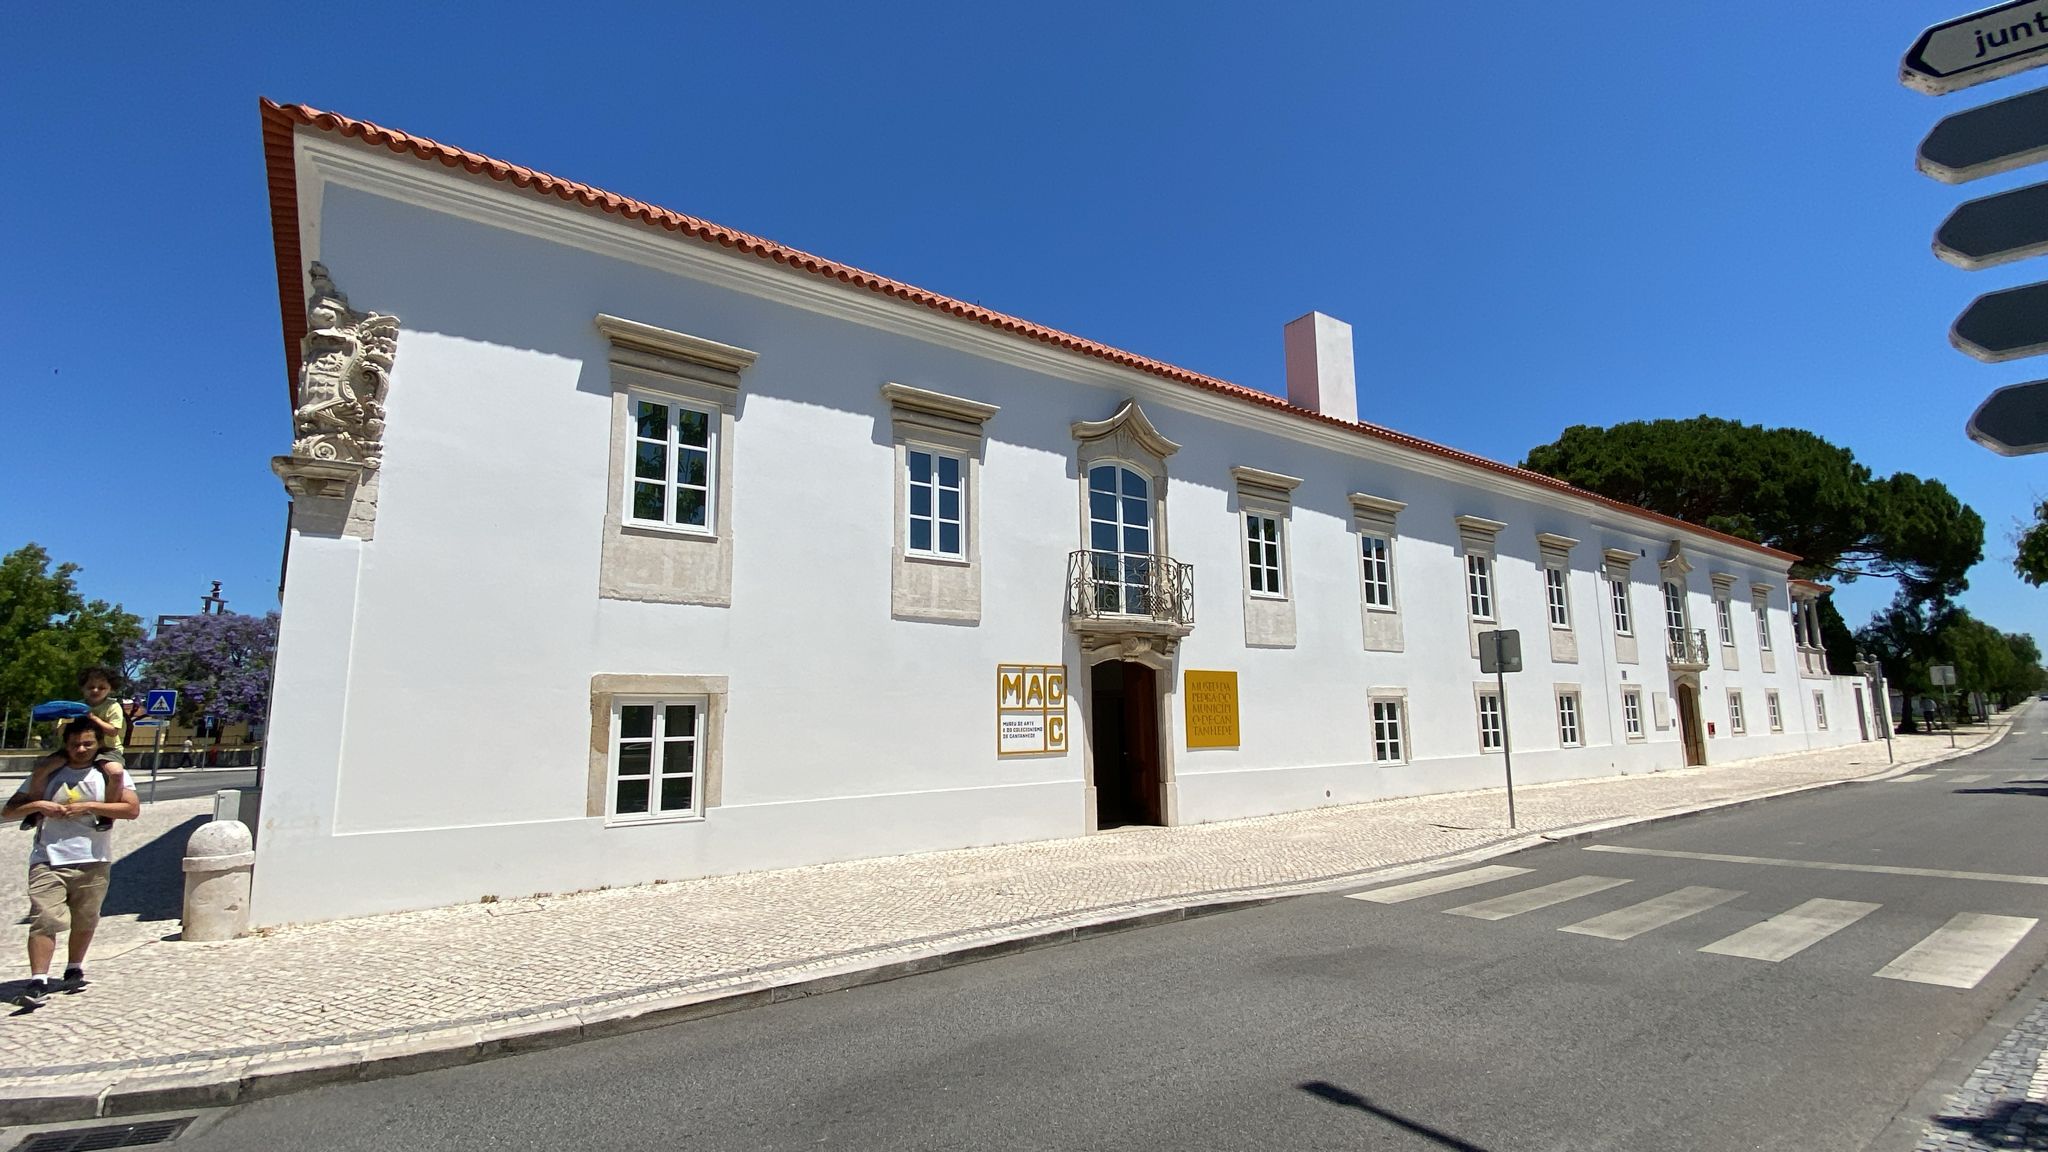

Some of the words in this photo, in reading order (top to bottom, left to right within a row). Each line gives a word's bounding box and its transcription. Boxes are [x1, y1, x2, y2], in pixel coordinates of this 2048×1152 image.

[1002, 674, 1063, 701] MAC
[1192, 681, 1218, 691] MUSEU
[1220, 681, 1230, 691] DA
[1192, 693, 1217, 702] PEDRA
[1219, 693, 1231, 703] DO
[1049, 717, 1063, 743] C
[1194, 726, 1232, 736] TANHEDE
